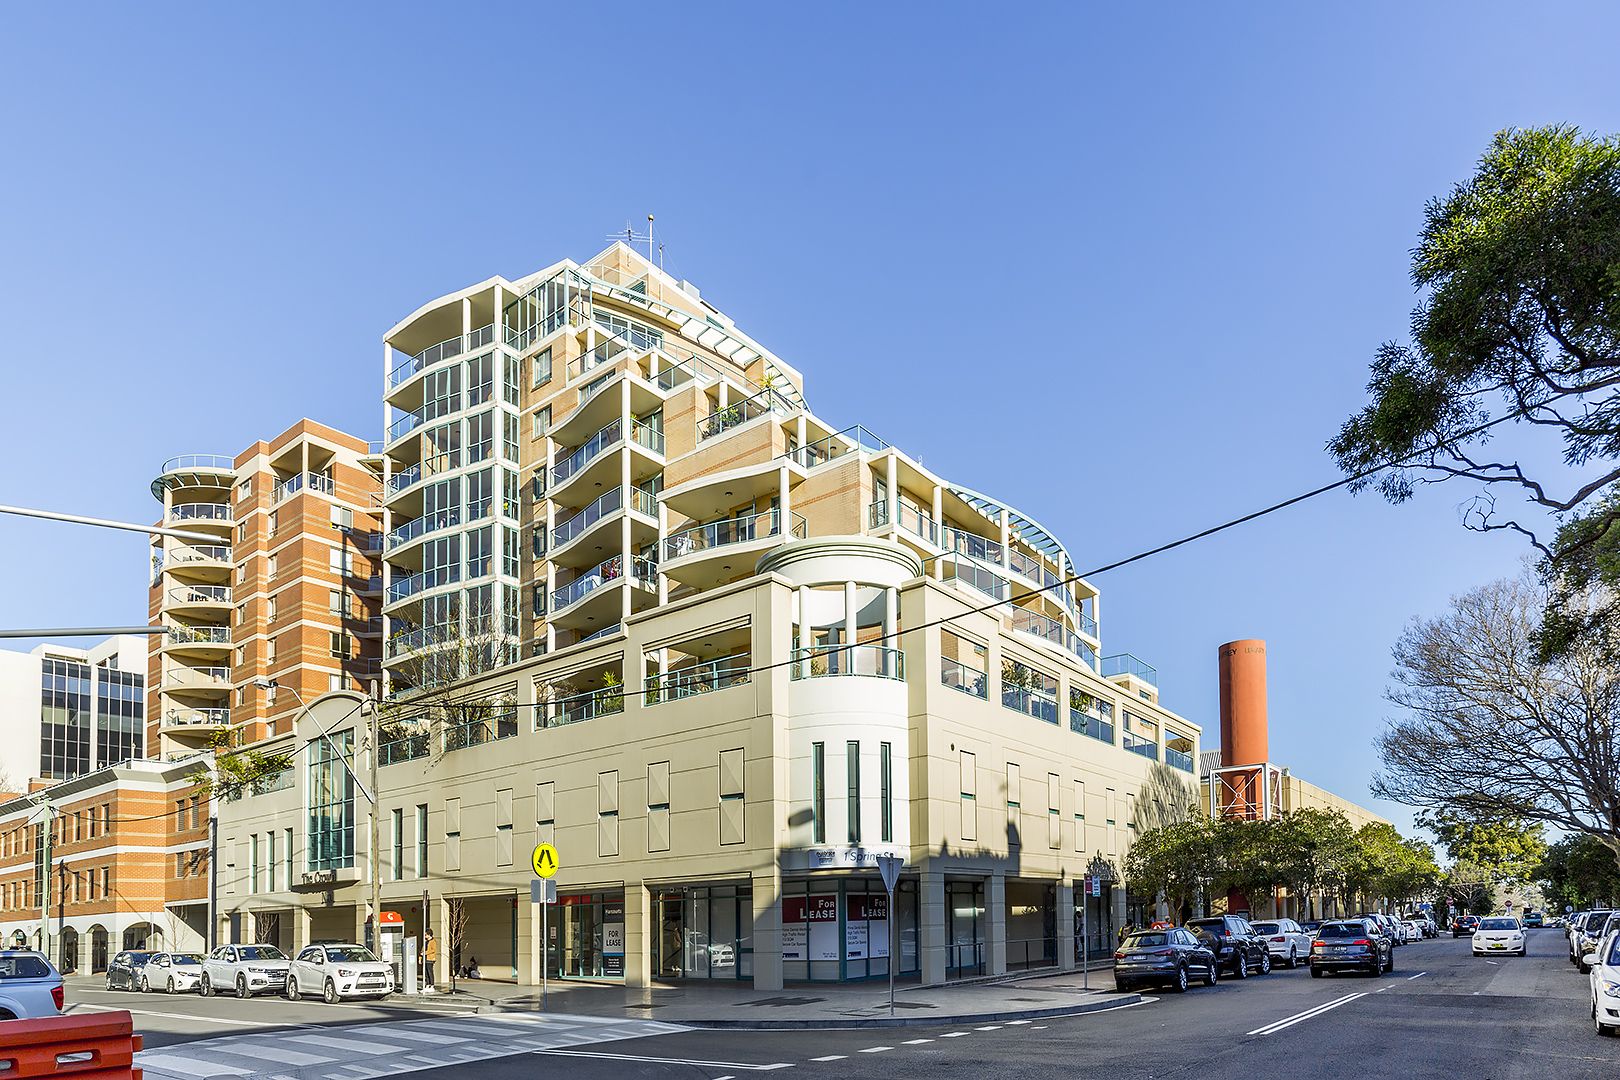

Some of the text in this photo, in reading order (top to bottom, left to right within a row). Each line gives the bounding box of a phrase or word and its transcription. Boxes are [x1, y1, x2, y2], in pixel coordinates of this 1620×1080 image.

[301, 873, 313, 885] The
[608, 930, 619, 938] FOR
[606, 939, 621, 947] LEASE
